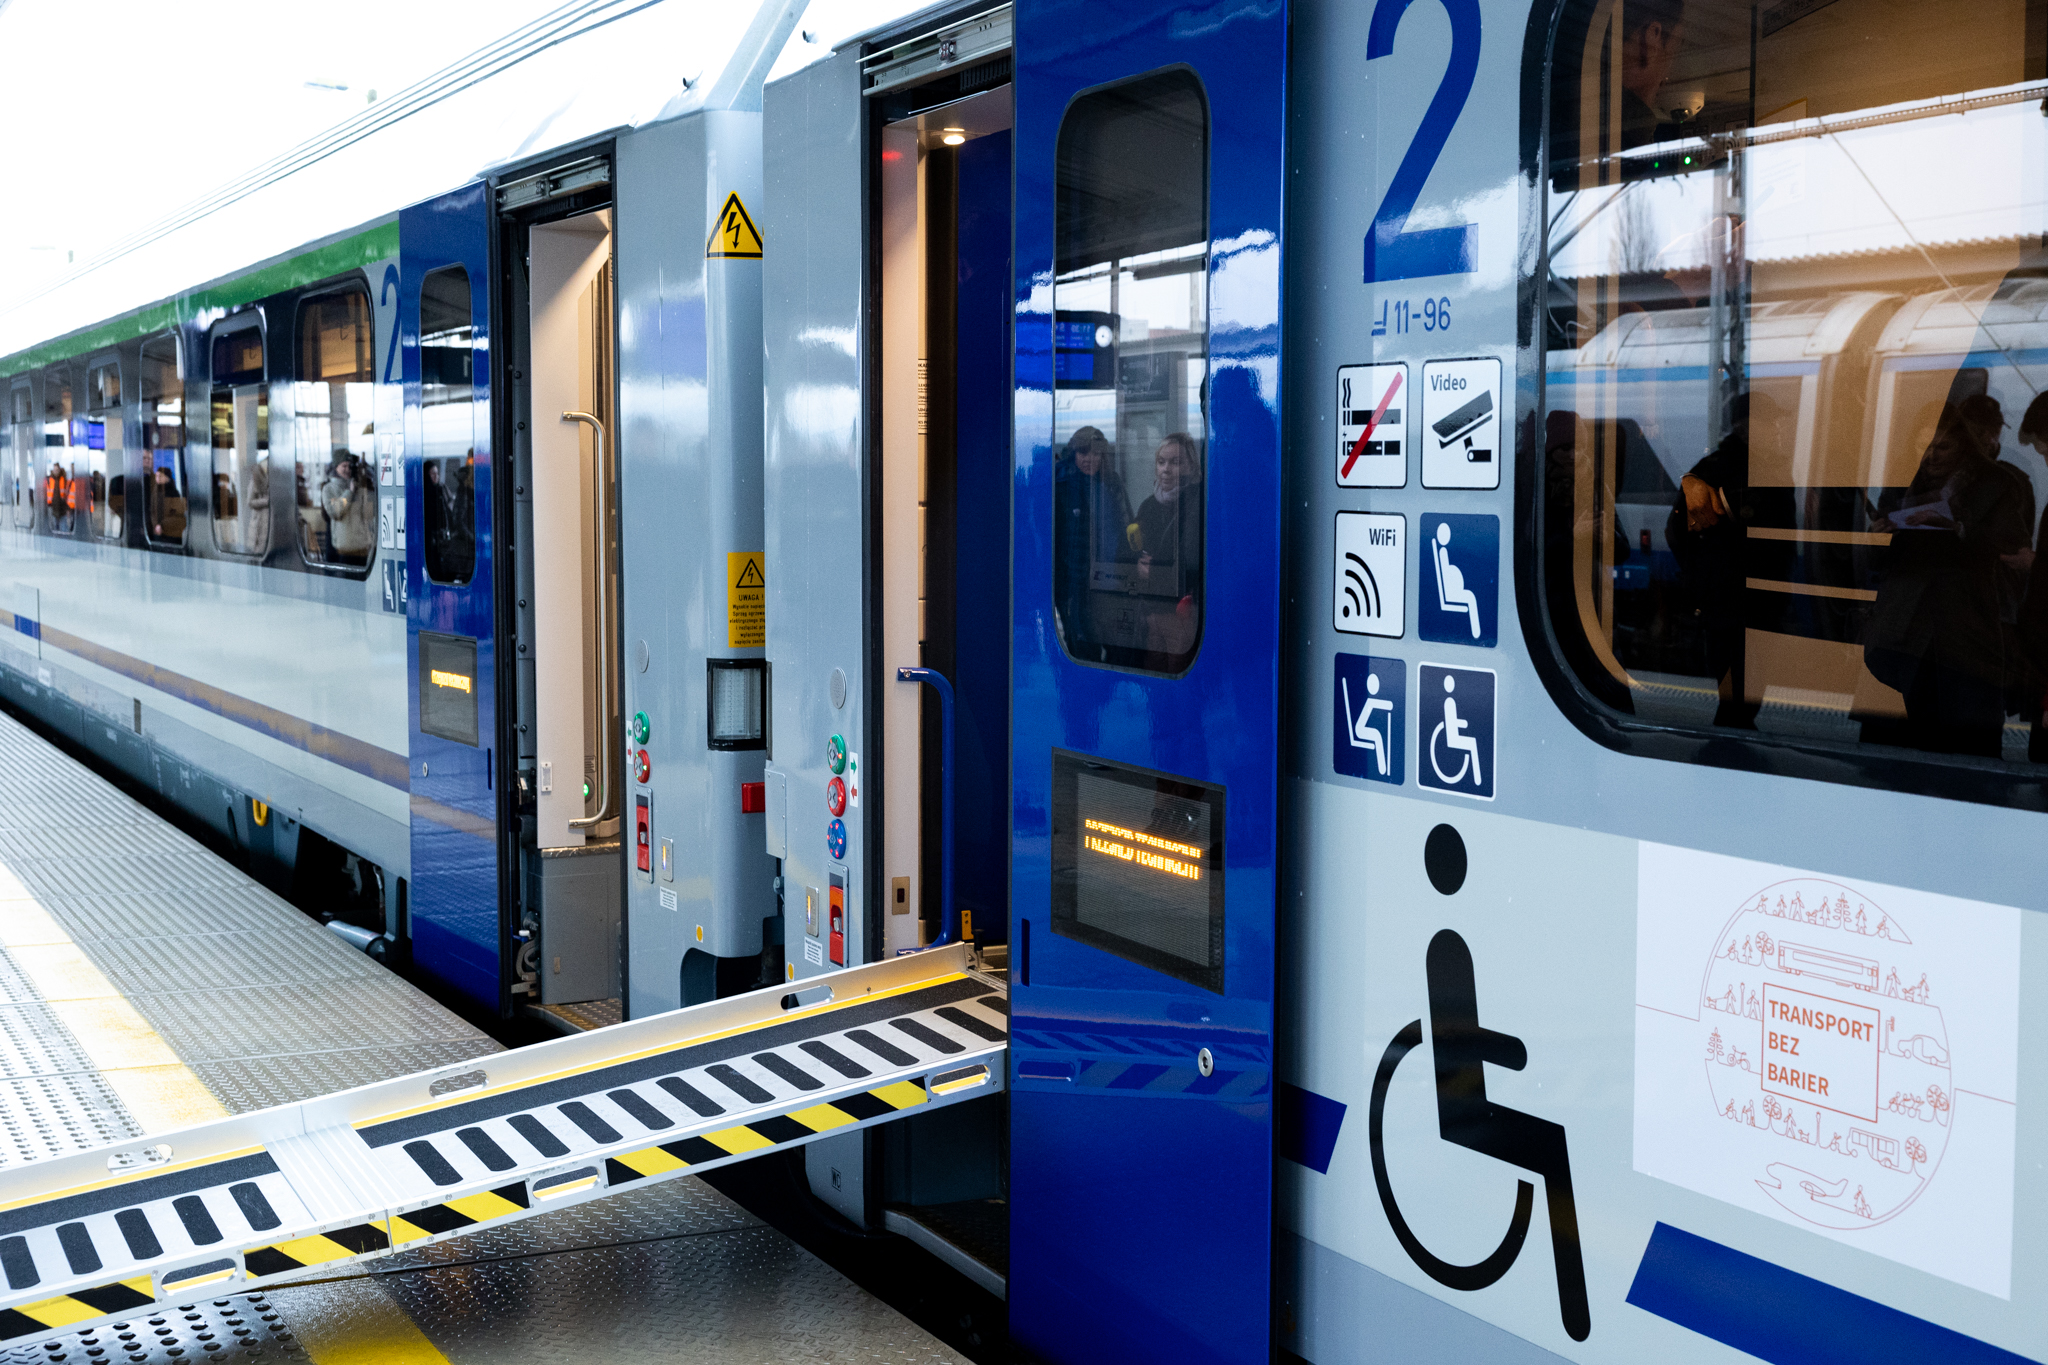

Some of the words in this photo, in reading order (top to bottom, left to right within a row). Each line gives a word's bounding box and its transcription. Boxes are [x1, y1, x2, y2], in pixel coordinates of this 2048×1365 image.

[1363, 0, 1482, 284] 2
[1394, 296, 1451, 334] 11-96
[1430, 373, 1467, 391] Video
[1369, 528, 1396, 546] WiFi
[1768, 999, 1874, 1042] TRANSPORT
[1768, 1031, 1800, 1056] BEZ
[1767, 1062, 1829, 1097] BARIER
